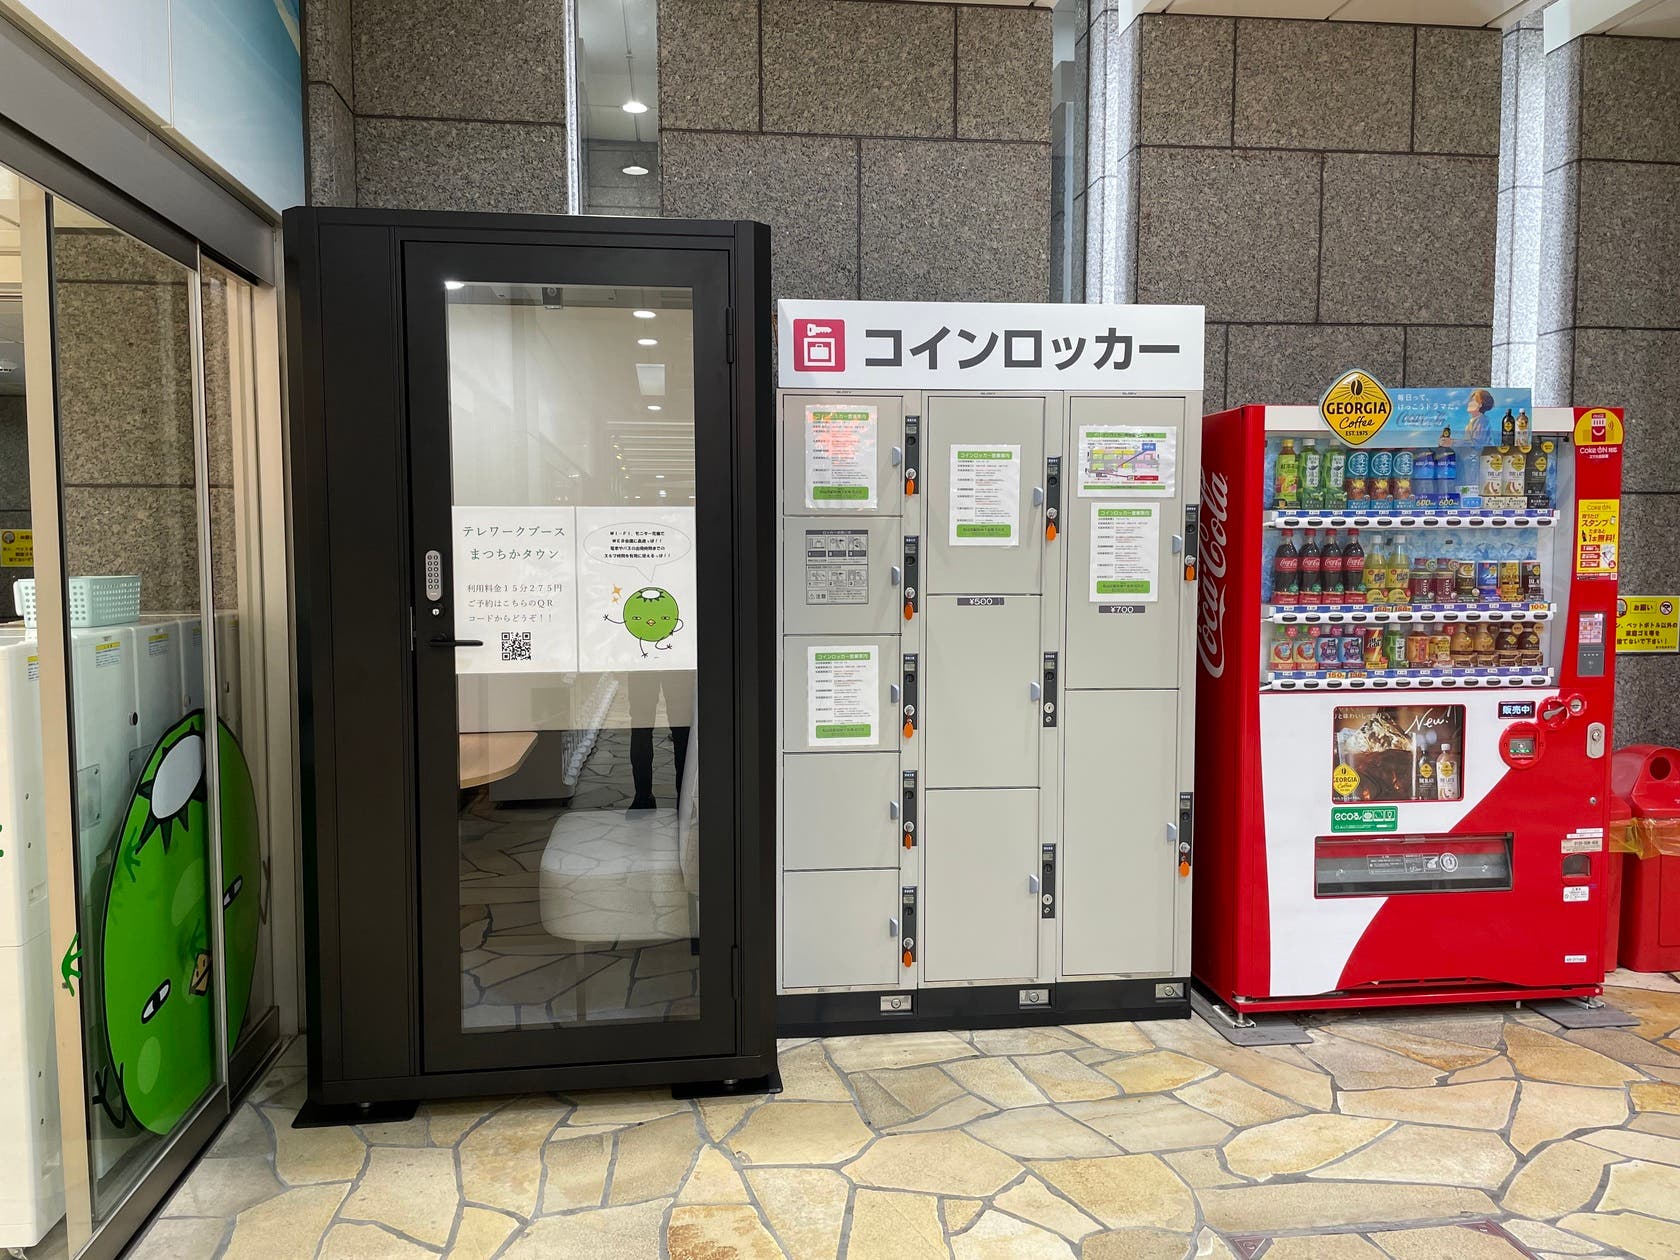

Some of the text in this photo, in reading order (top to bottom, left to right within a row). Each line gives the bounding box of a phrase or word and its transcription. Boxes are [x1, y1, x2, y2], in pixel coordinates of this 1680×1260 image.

[864, 326, 1180, 370] コインロッカー
[1326, 402, 1385, 415] GEORGIA
[1339, 416, 1374, 430] Coffee
[463, 526, 565, 537] テレワークブース
[470, 549, 559, 560] まつちかタウン
[1197, 471, 1228, 678] Coca-Cola
[468, 584, 562, 592] 利用料金15分275円
[468, 599, 553, 608] ご予約はこちらのQR
[469, 614, 552, 622] コードからどうぞ！！
[1502, 705, 1530, 714] 販売中
[1404, 705, 1452, 734] New!
